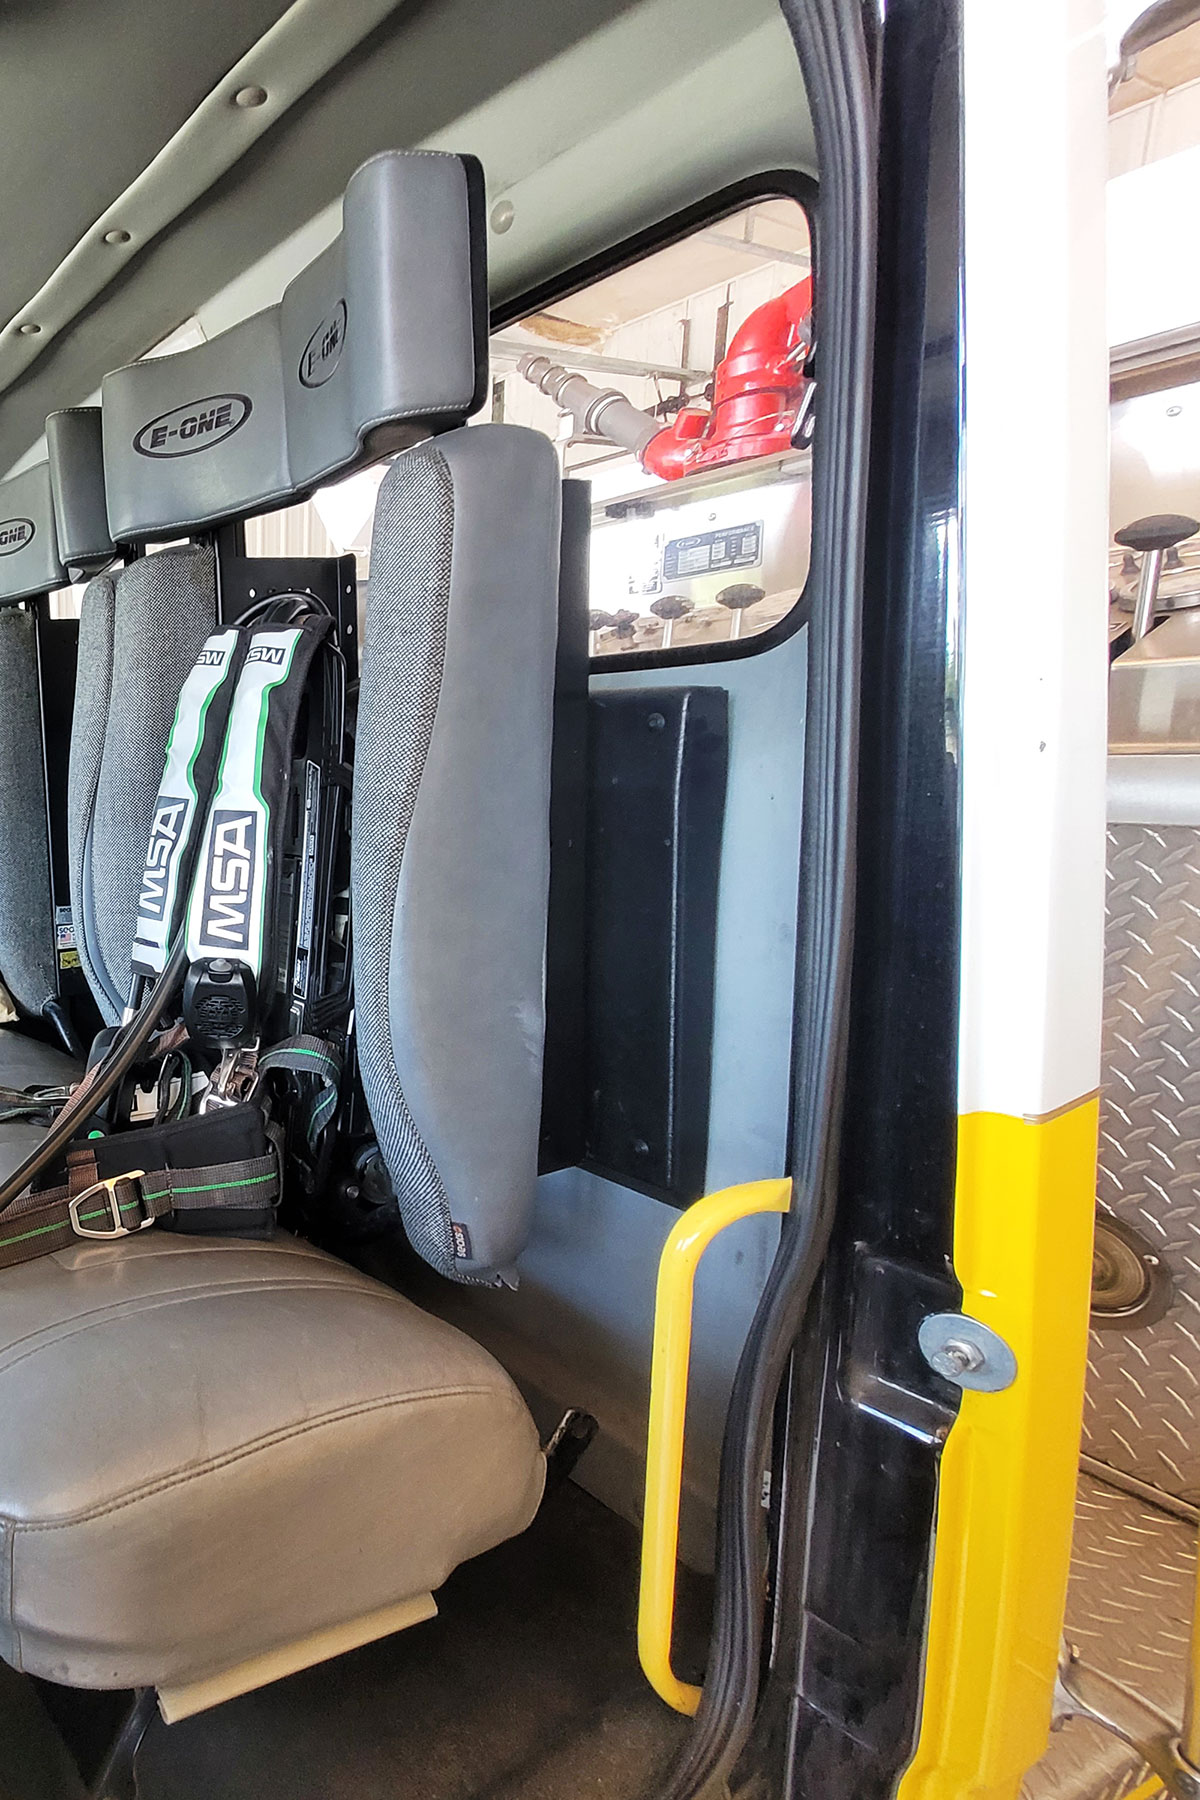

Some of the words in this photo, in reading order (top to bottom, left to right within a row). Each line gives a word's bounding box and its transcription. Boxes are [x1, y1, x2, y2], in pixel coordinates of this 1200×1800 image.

[150, 403, 233, 449] E-ONE
[139, 802, 185, 914] MSA
[206, 815, 253, 943] MSA
